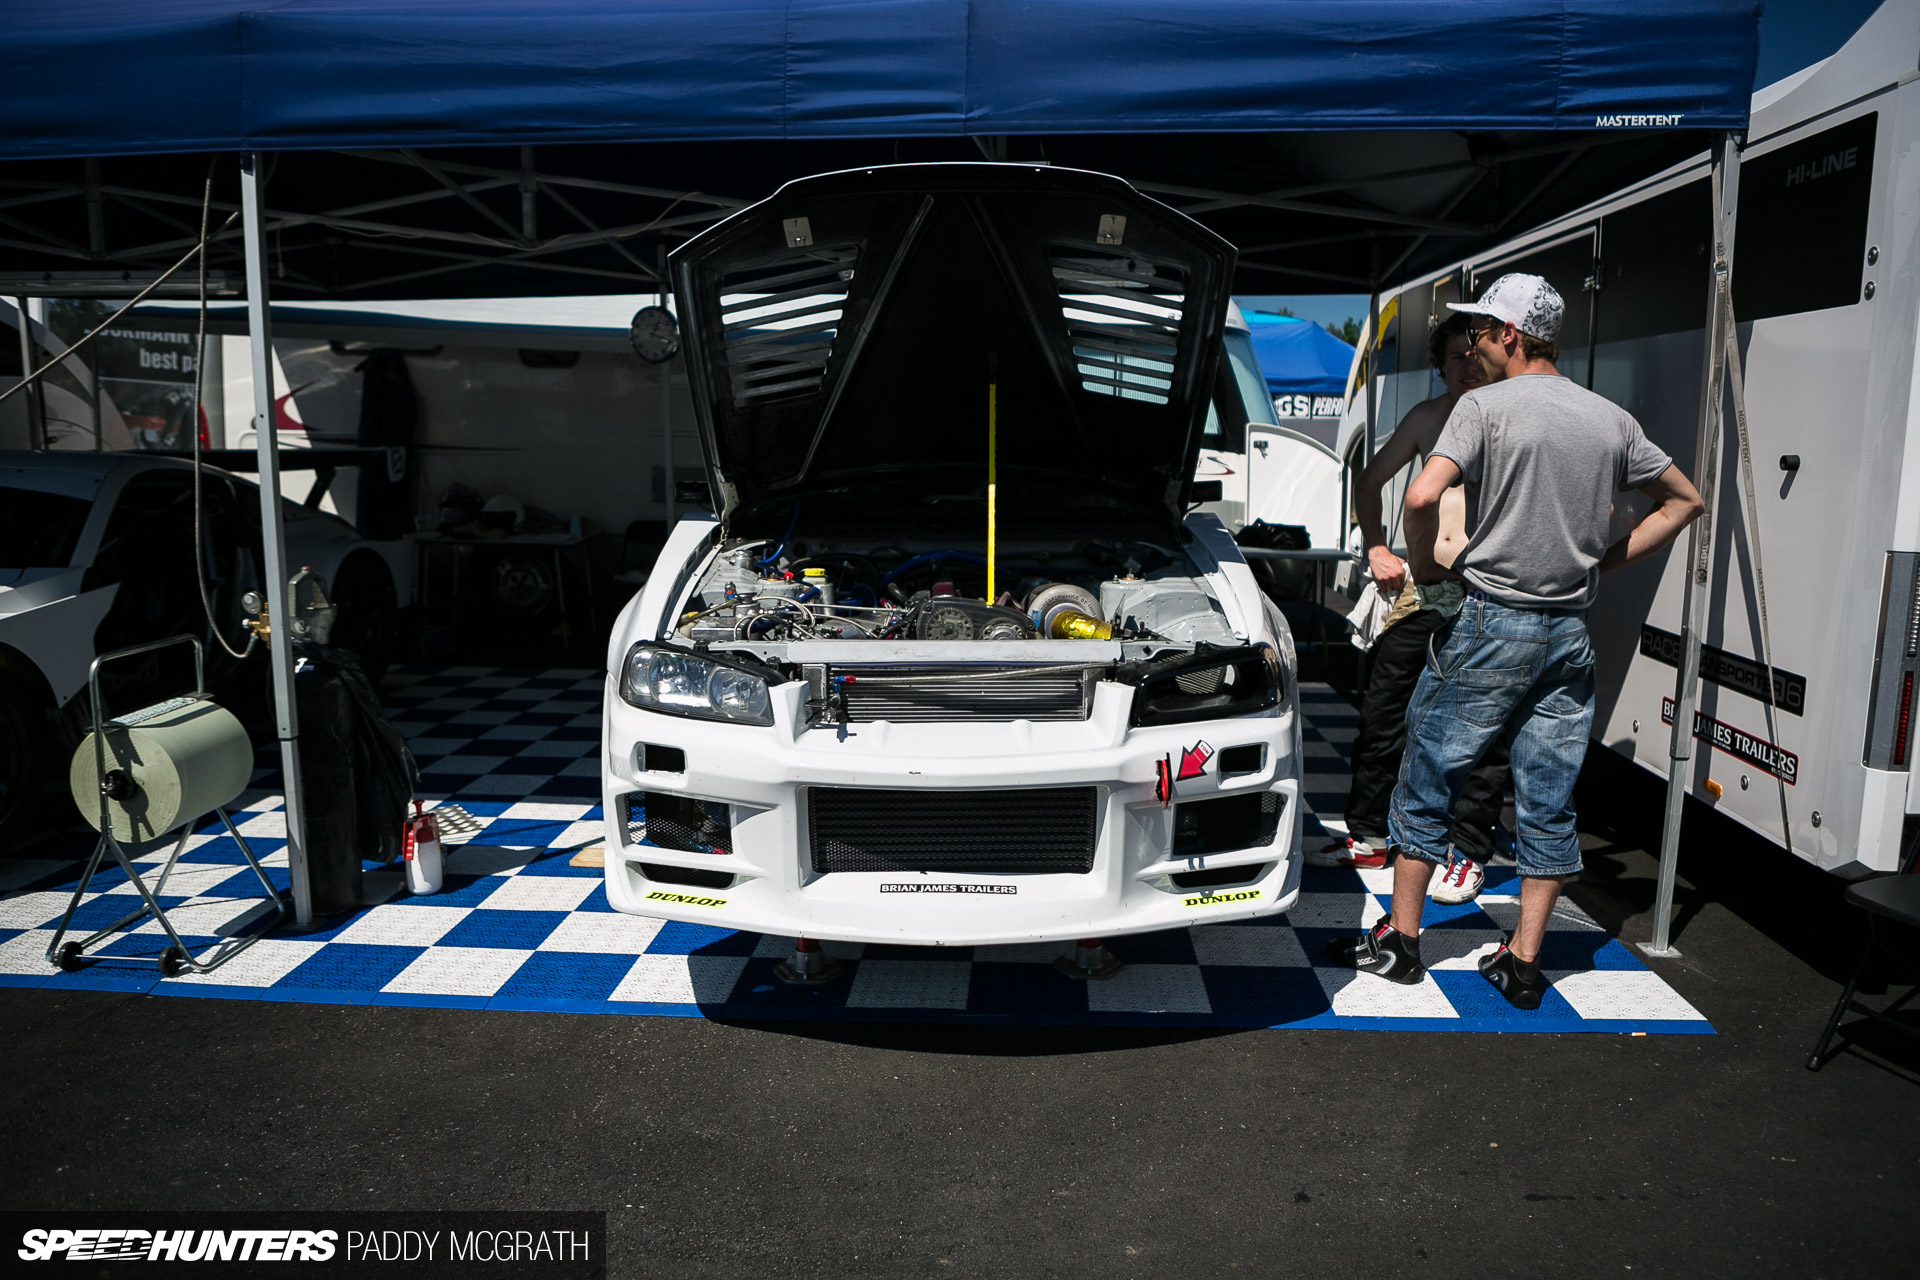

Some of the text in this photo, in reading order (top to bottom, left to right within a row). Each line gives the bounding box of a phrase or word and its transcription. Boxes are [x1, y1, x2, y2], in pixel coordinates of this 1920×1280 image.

[1595, 114, 1682, 127] MASTERTENT
[1786, 146, 1858, 188] HI-LINE
[139, 347, 179, 370] best
[1700, 655, 1782, 697] ANSPORTER
[1786, 681, 1802, 707] 6
[1694, 713, 1732, 745] JAMES
[1734, 732, 1796, 775] TRAILERS
[881, 884, 1017, 894] BRIAN JAMES TRAILERS
[1184, 890, 1260, 906] DUNLOP
[645, 891, 727, 907] DUNLOP
